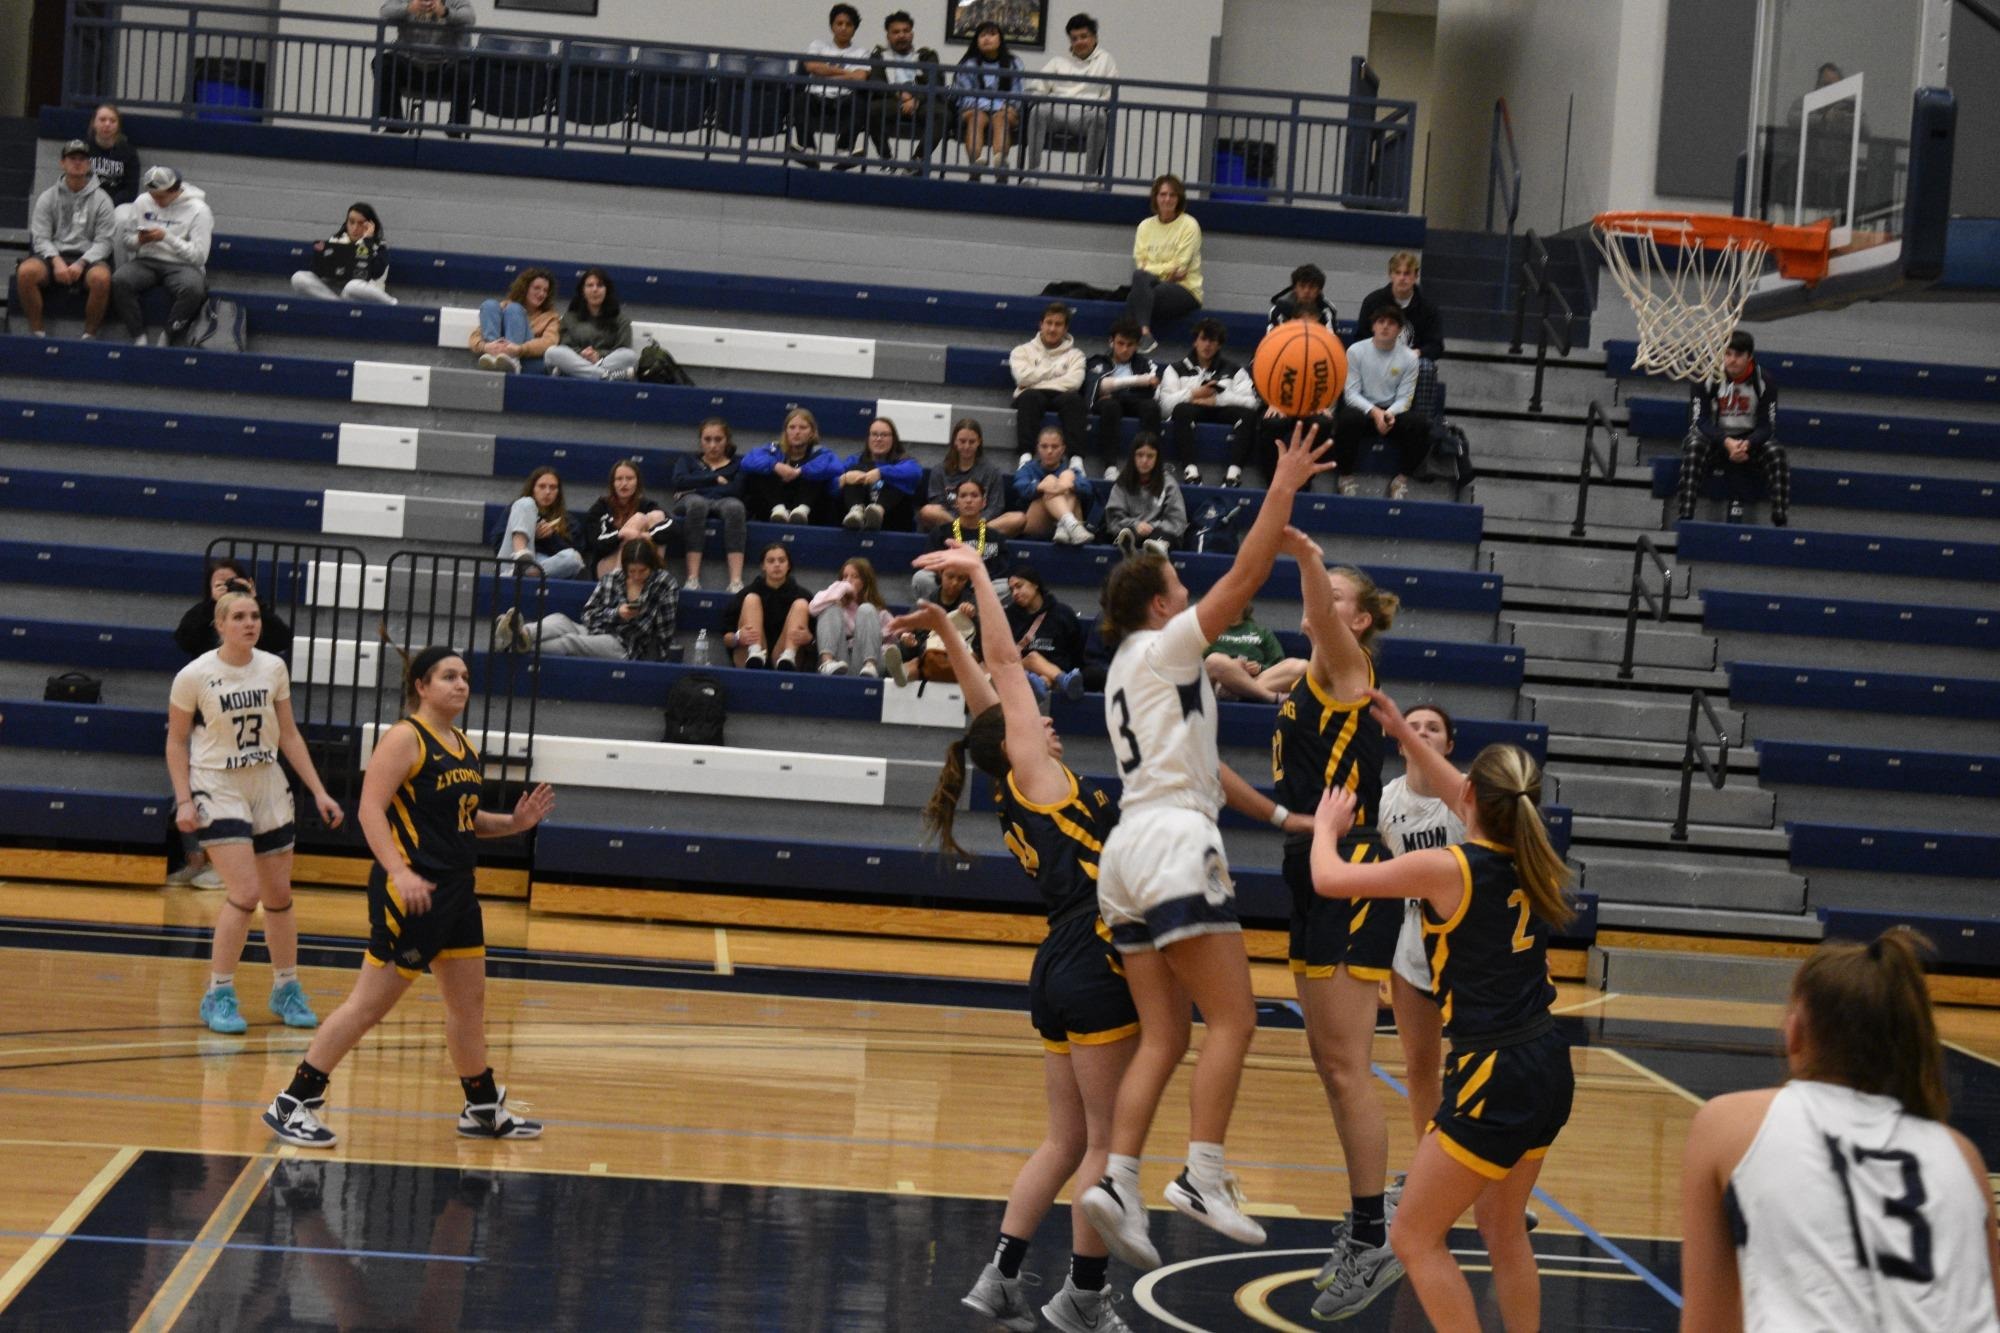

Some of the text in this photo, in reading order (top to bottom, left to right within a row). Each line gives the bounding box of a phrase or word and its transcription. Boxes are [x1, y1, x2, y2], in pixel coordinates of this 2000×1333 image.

[219, 689, 268, 713] MOUNT
[232, 714, 262, 751] 23
[1112, 688, 1142, 774] 3
[1507, 889, 1535, 954] 2
[1824, 1132, 1935, 1284] 13
